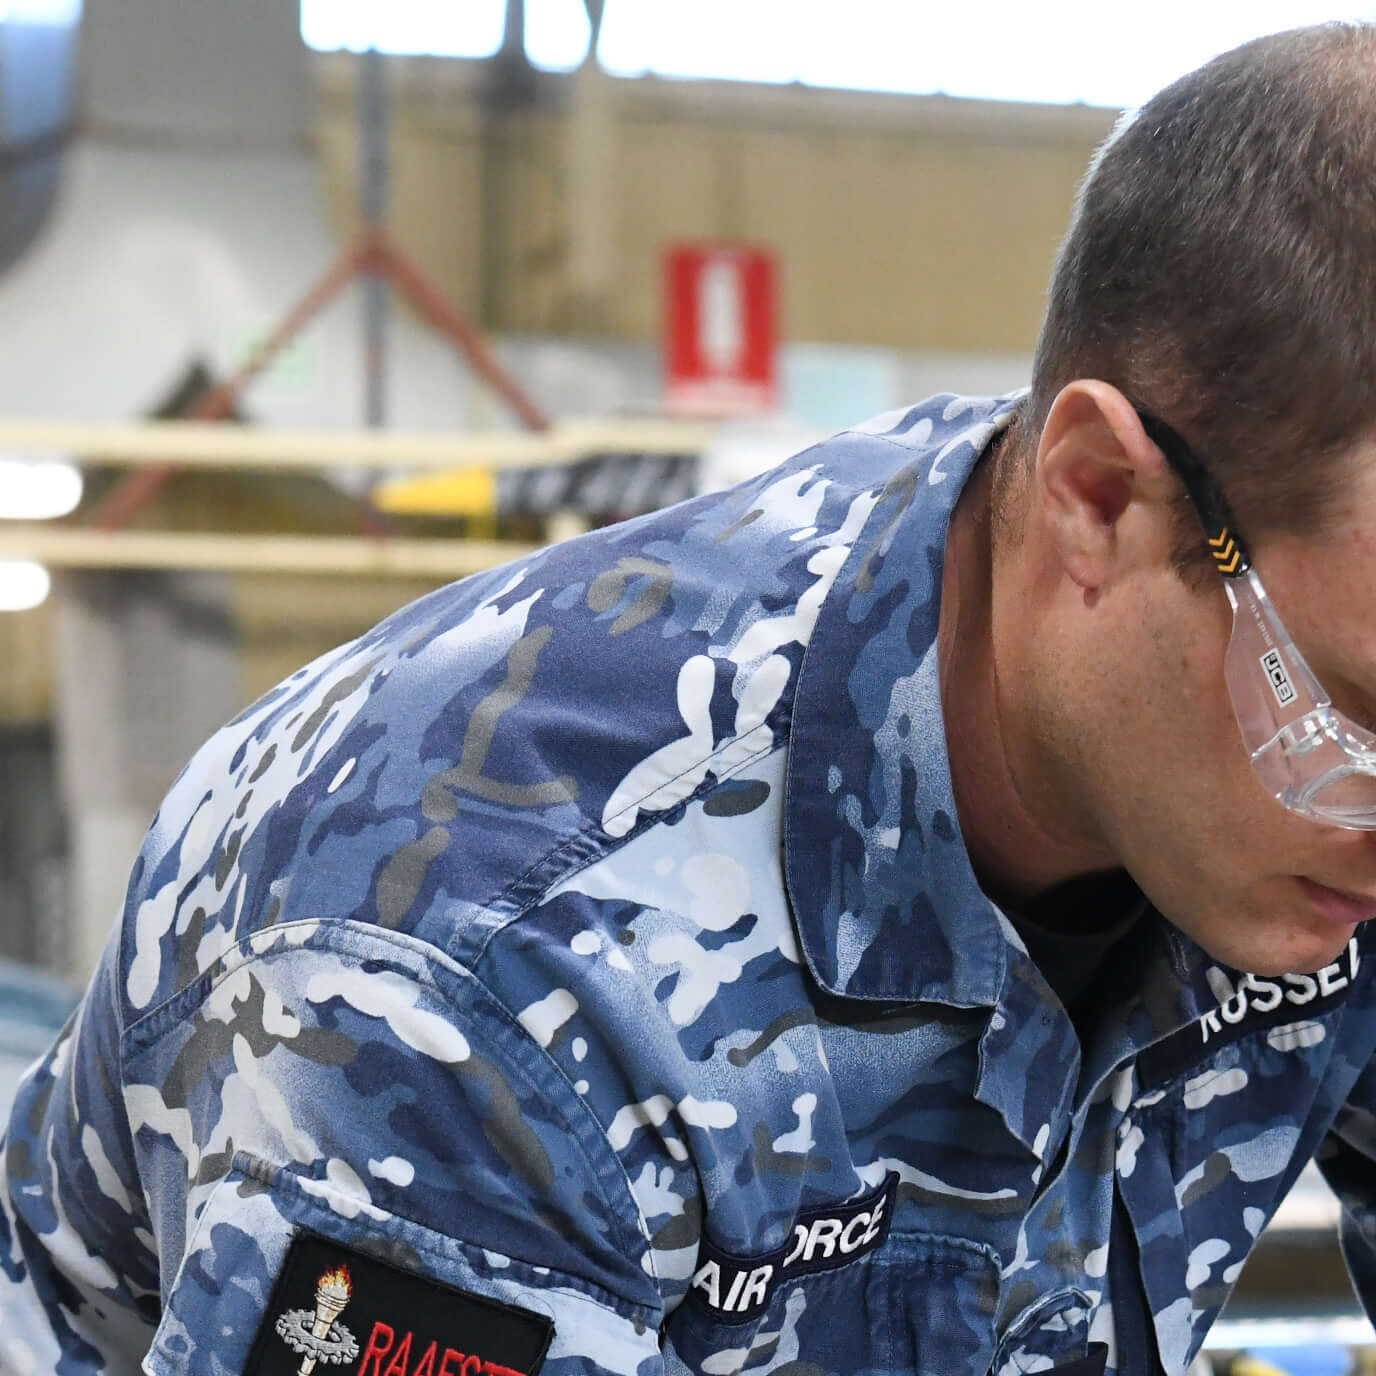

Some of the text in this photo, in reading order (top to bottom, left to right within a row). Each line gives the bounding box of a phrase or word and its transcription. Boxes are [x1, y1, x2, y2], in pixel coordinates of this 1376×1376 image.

[1262, 650, 1295, 704] JCB
[692, 1193, 887, 1312] AIR ORCE
